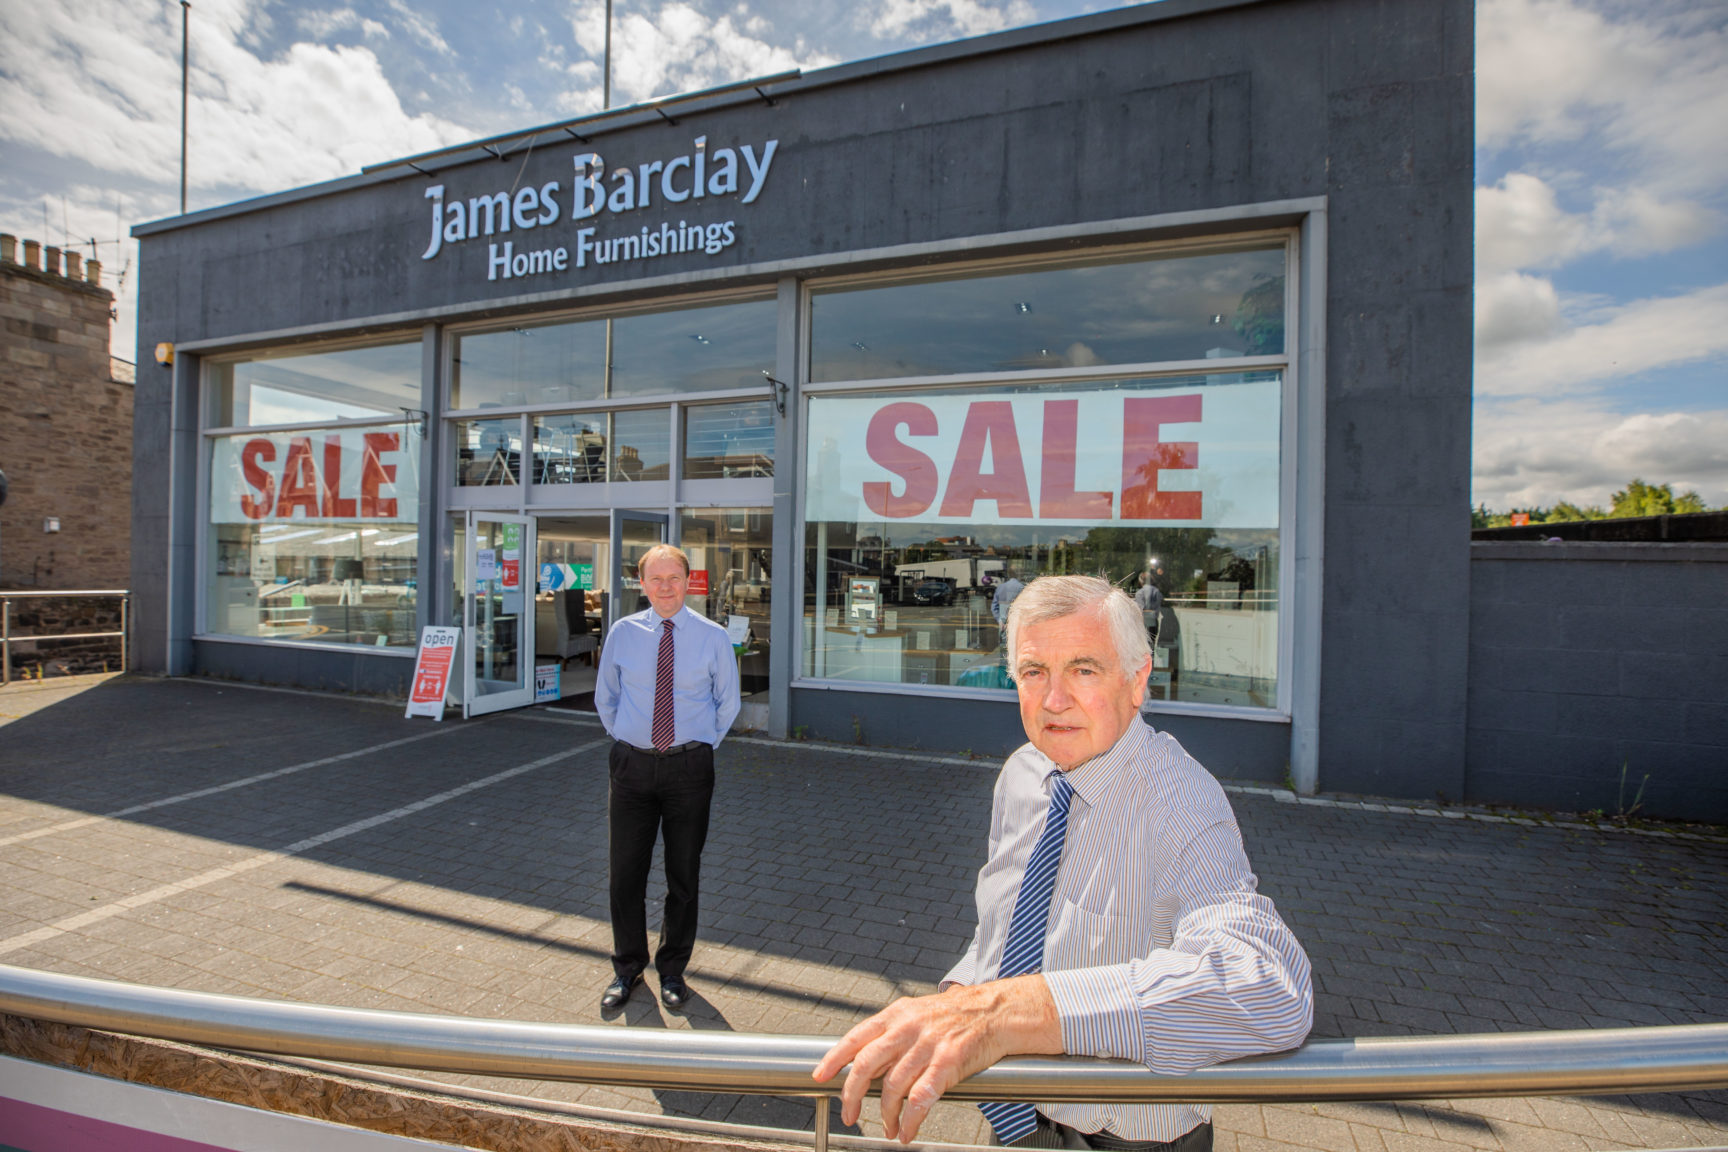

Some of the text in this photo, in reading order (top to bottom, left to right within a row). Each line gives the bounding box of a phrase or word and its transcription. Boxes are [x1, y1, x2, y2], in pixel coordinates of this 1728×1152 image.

[421, 135, 779, 260] James Barclay
[487, 220, 736, 281] Home Furnishings
[240, 432, 399, 519] SALE
[863, 394, 1203, 520] SALE
[425, 634, 455, 647] open
